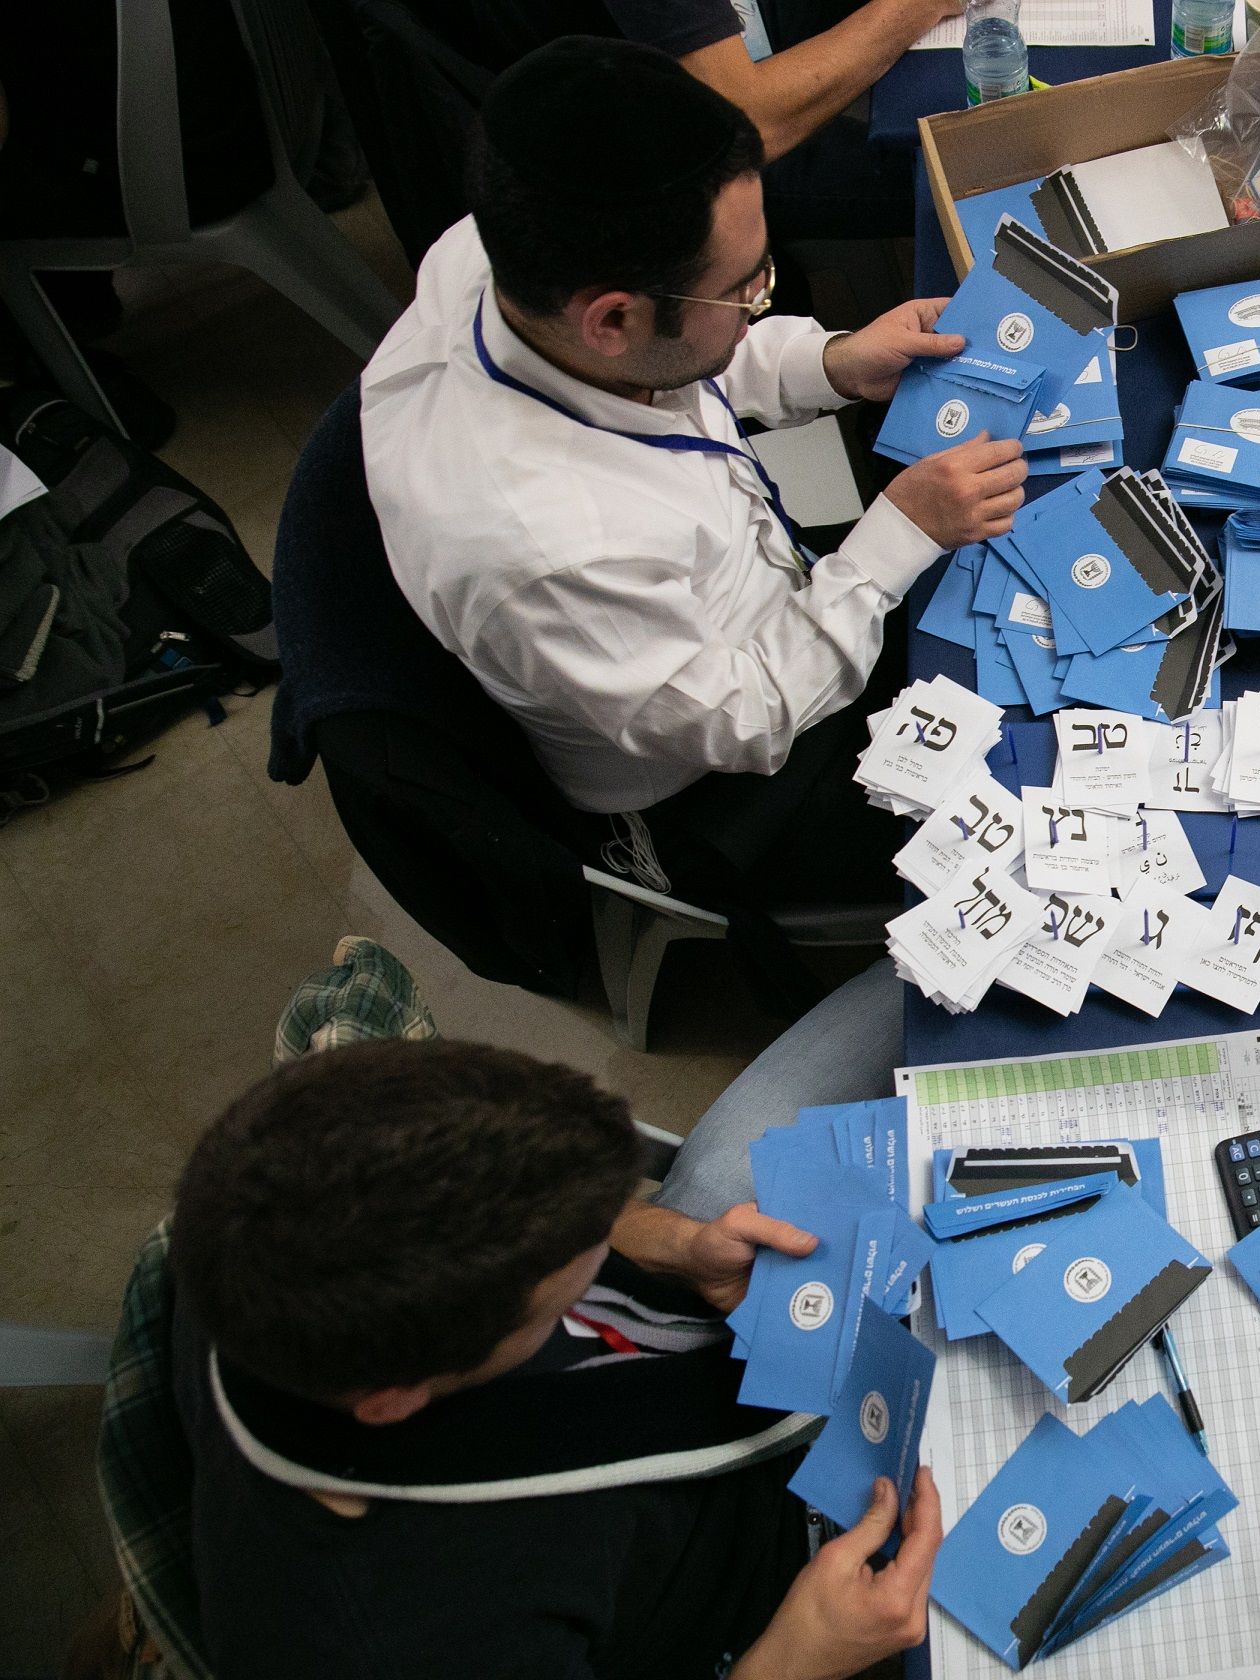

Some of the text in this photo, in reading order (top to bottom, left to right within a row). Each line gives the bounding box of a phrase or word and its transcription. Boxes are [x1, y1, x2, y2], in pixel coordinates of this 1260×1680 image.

[896, 706, 957, 751] פה
[1072, 723, 1127, 751] טב
[950, 795, 1014, 852] טב
[1042, 806, 1087, 848] נץ
[955, 867, 1011, 939] מחל
[1140, 910, 1169, 949] ג
[1232, 1147, 1242, 1160] AC
[1251, 1145, 1259, 1154] C
[1239, 1172, 1247, 1181] 0
[956, 1184, 1086, 1215] הבחירות לכנסת העשרים ושלוש
